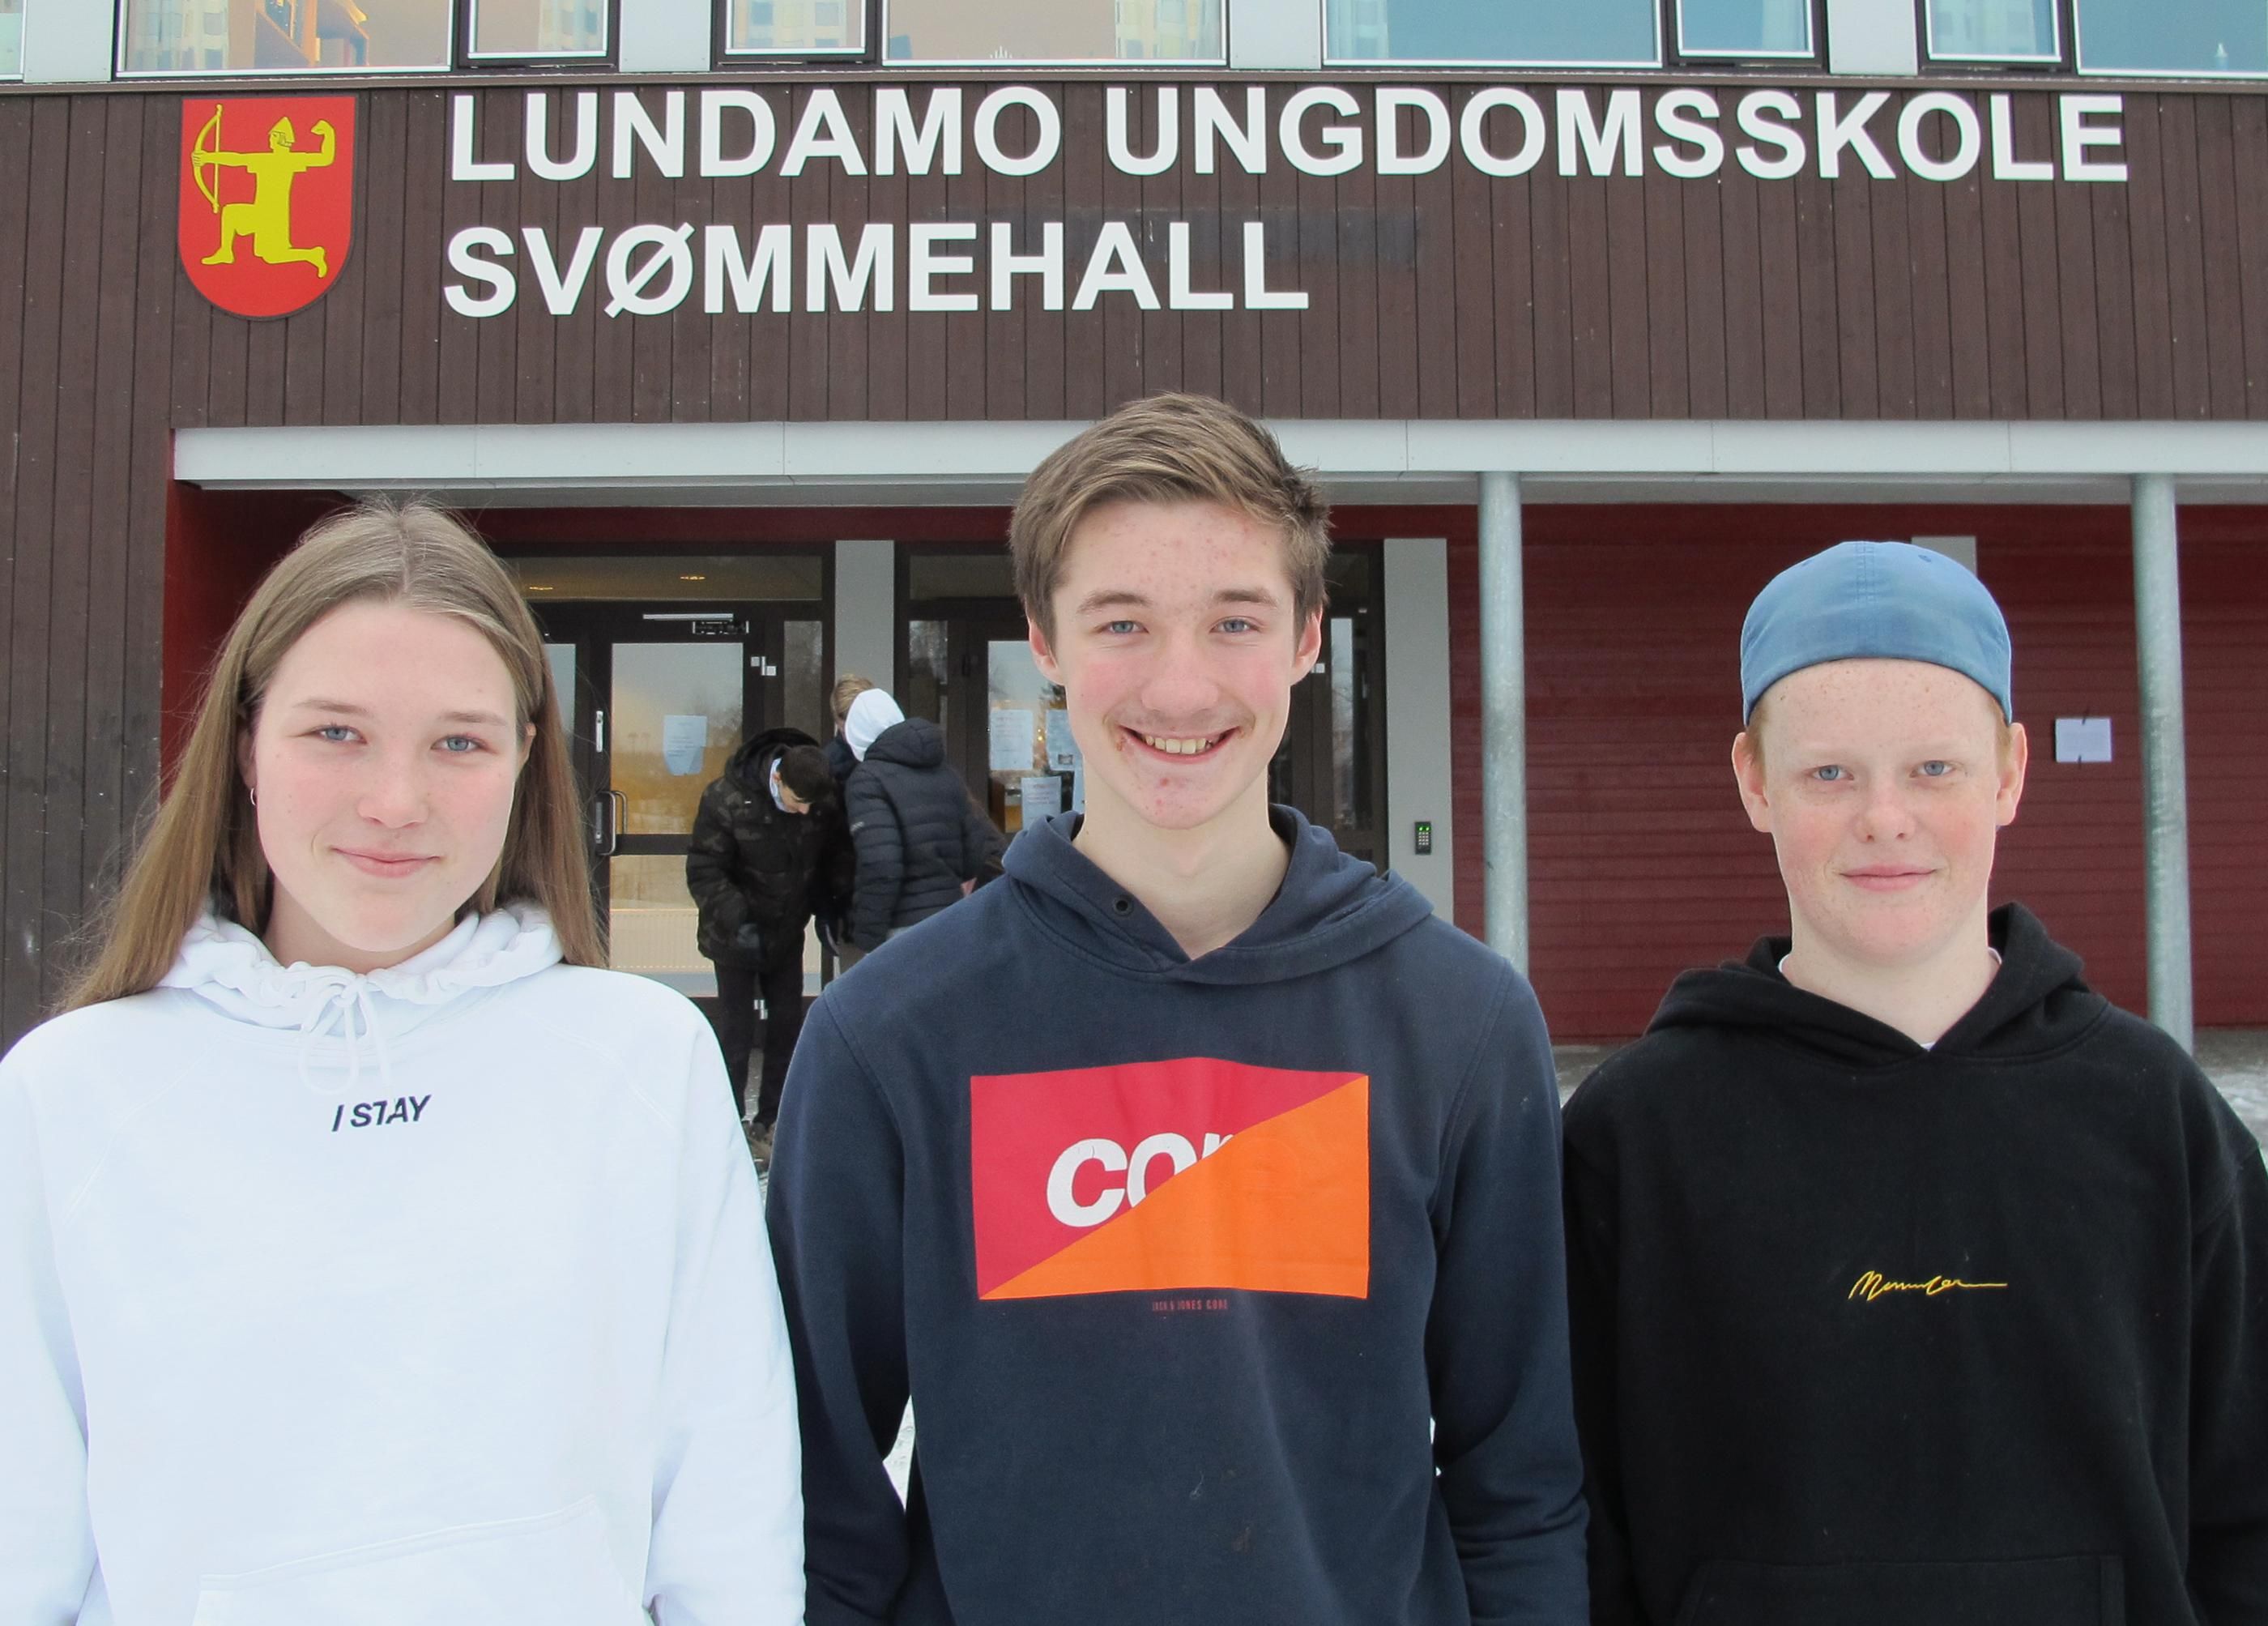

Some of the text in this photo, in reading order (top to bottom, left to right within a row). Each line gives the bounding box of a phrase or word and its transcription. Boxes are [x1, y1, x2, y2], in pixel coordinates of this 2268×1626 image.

[451, 86, 2129, 181] LUNDAMO UNGDOMSSKOLE
[443, 221, 1309, 318] SVØMMEHALL
[331, 1094, 432, 1132] I STAY
